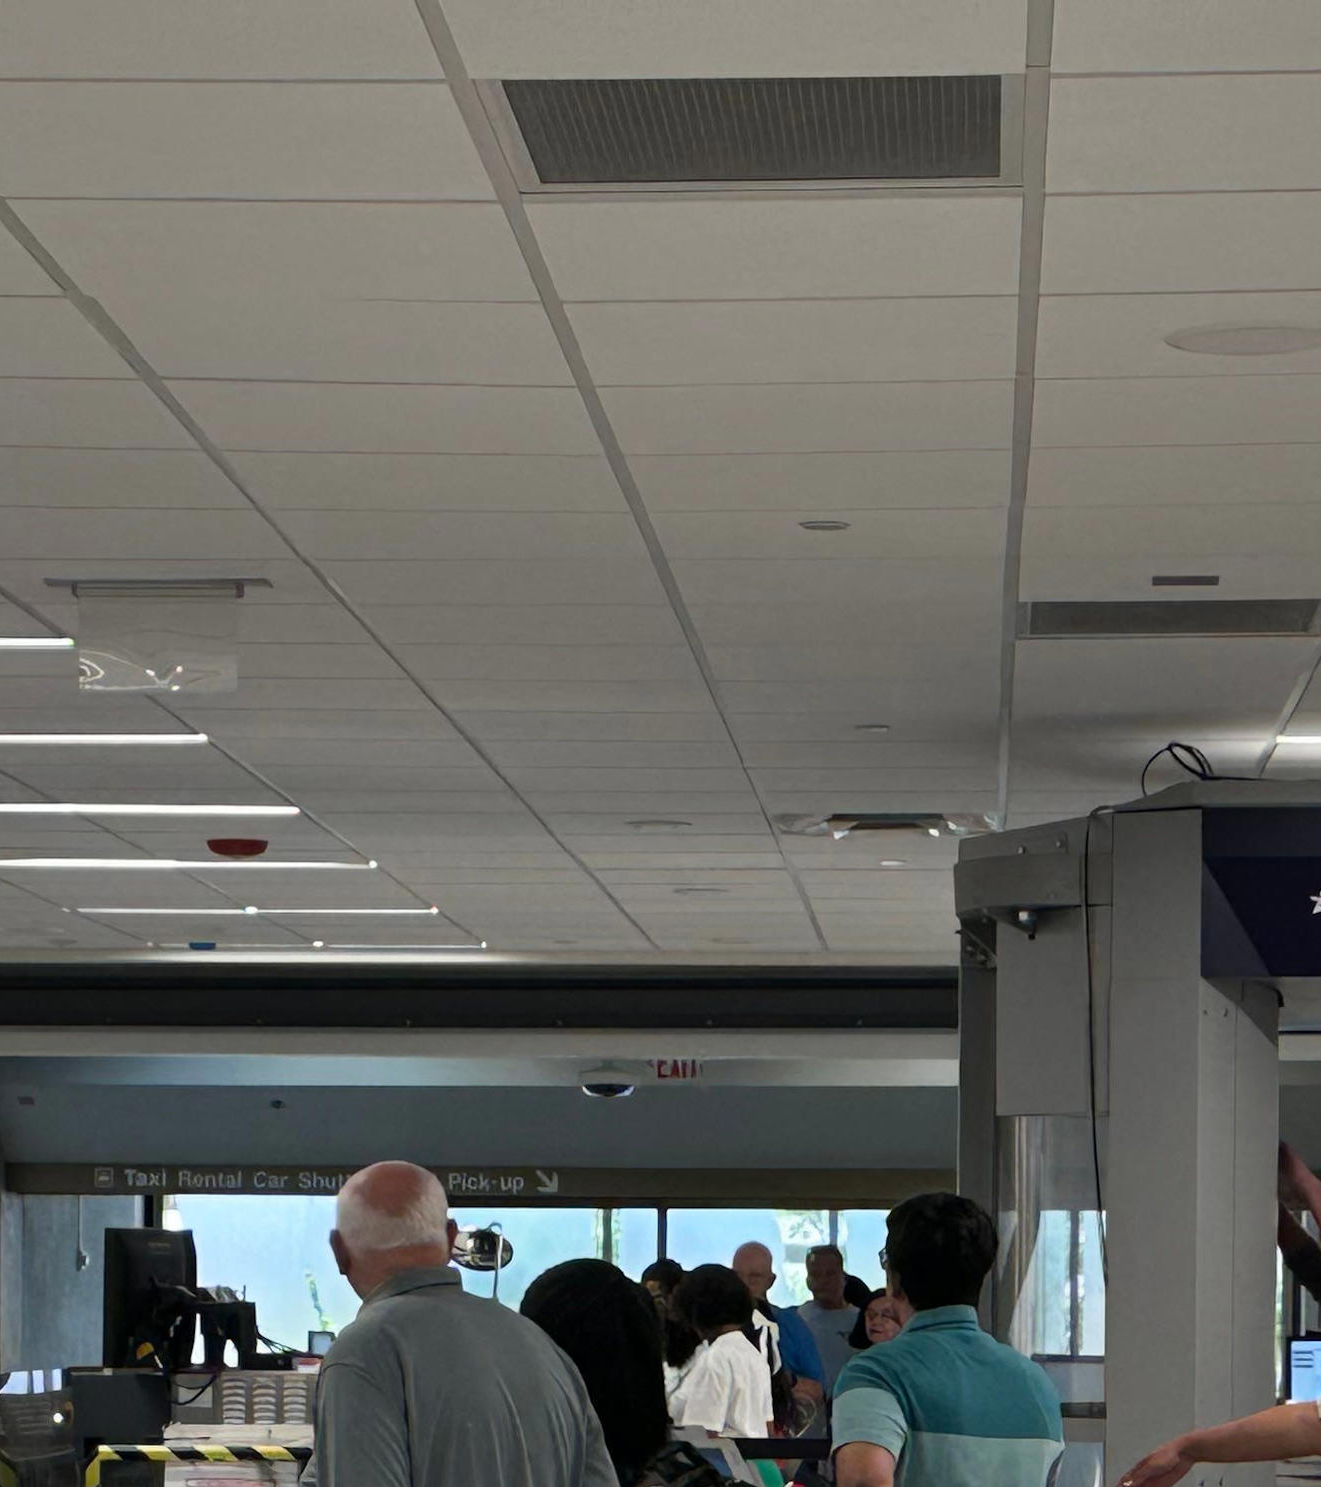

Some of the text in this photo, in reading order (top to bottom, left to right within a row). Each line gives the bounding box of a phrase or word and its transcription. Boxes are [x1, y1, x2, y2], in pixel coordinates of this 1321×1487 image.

[124, 1168, 166, 1187] Taxi
[178, 1170, 242, 1188] Rental
[253, 1171, 289, 1188] Car
[448, 1172, 525, 1194] Pick-up
